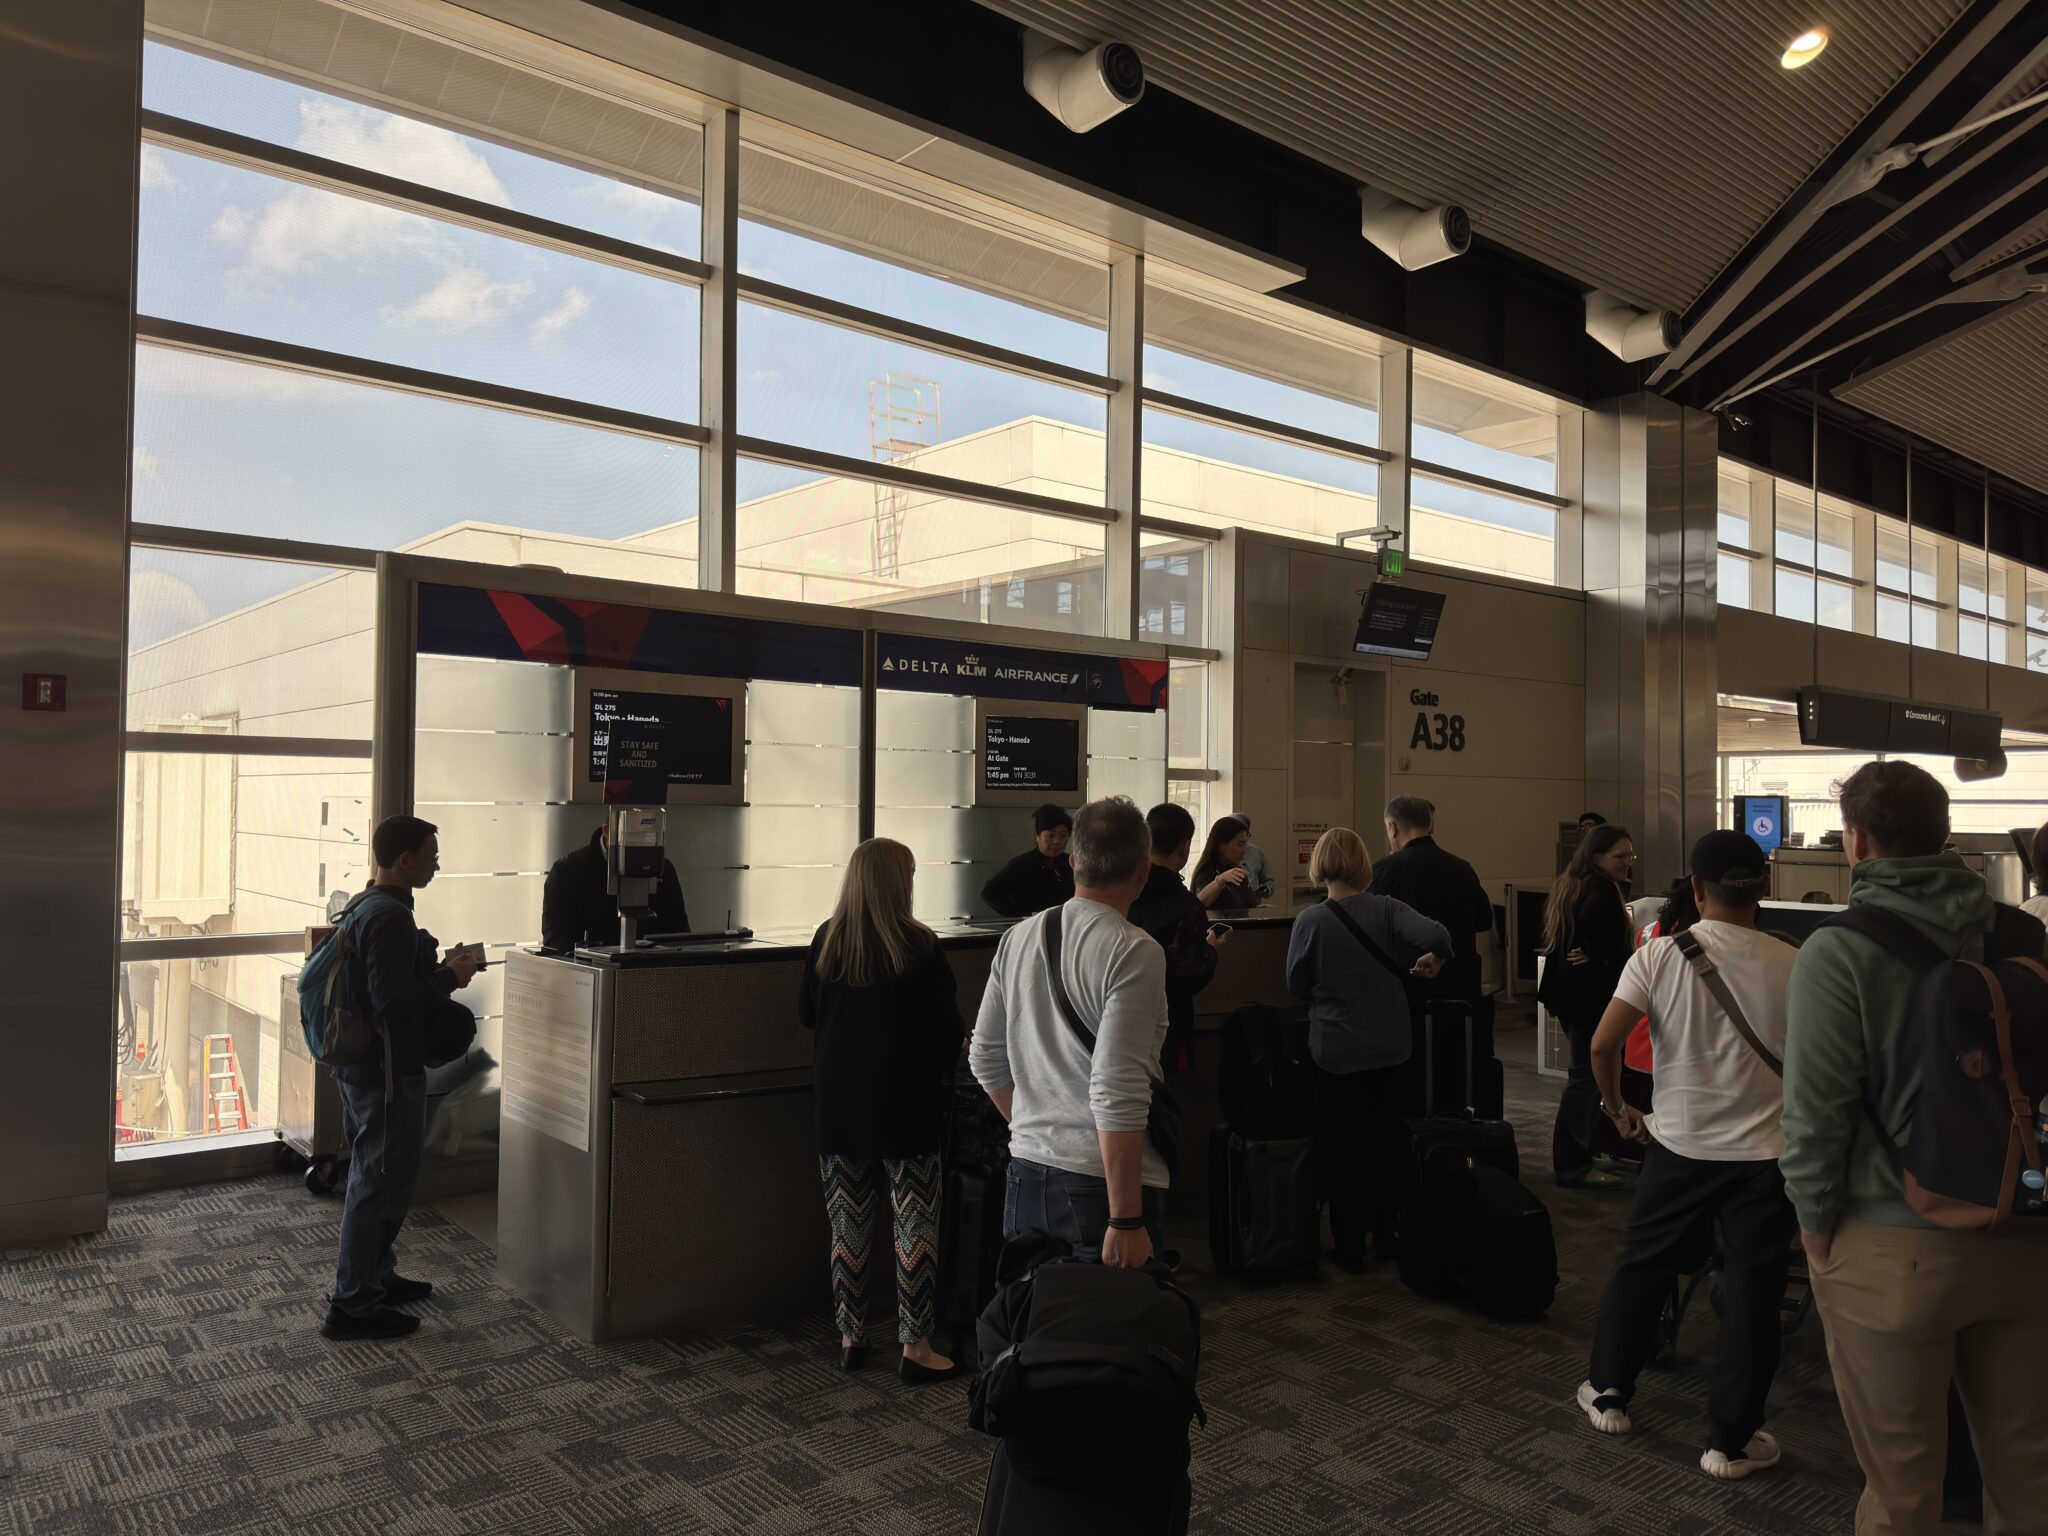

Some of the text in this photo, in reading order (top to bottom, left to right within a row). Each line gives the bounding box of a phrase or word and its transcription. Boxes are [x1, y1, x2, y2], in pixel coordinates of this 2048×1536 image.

[900, 659, 1068, 684] DELTA KLM AIRFRANCE
[1410, 689, 1439, 707] Gate
[1410, 712, 1465, 751] A38
[988, 736, 1005, 744] Tokyo
[1009, 736, 1030, 744] Haneda
[621, 740, 659, 750] STAY SAFE
[631, 750, 647, 758] AND
[620, 759, 657, 768] SANITIZED
[987, 771, 999, 779] 1:45
